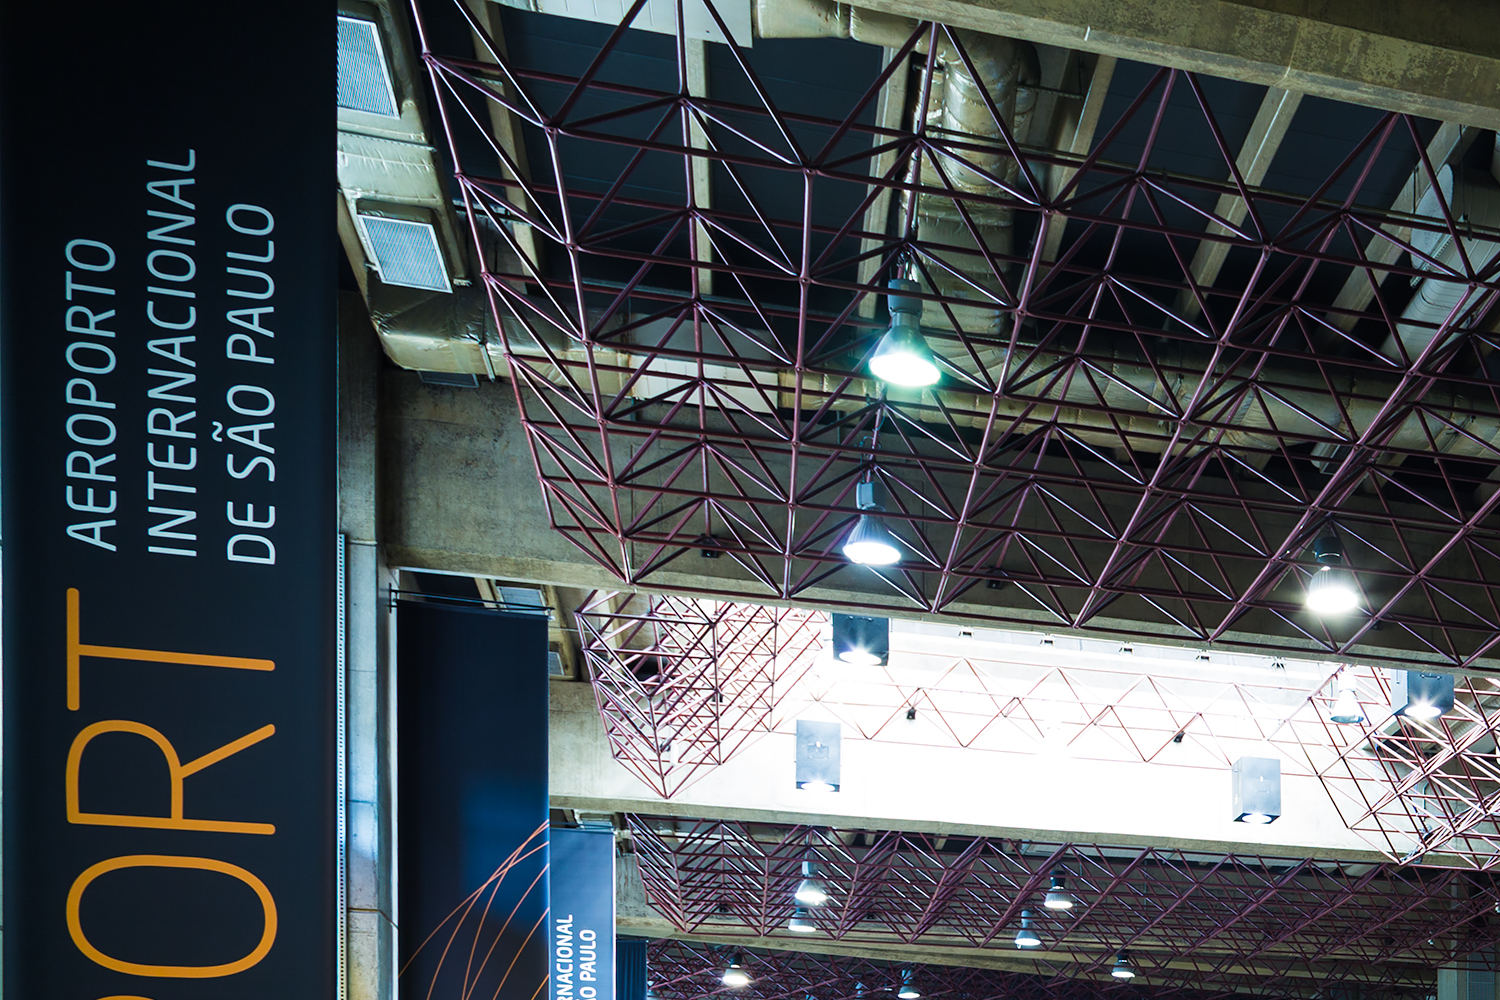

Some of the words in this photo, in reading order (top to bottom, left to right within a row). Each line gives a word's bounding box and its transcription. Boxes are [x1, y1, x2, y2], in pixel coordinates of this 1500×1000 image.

[227, 202, 276, 364] PAULO
[66, 237, 116, 552] AEROPORTO
[146, 148, 197, 557] INTERNACIONAL
[212, 384, 276, 483] SÃO
[227, 501, 276, 566] DE
[579, 929, 597, 982] PAULO
